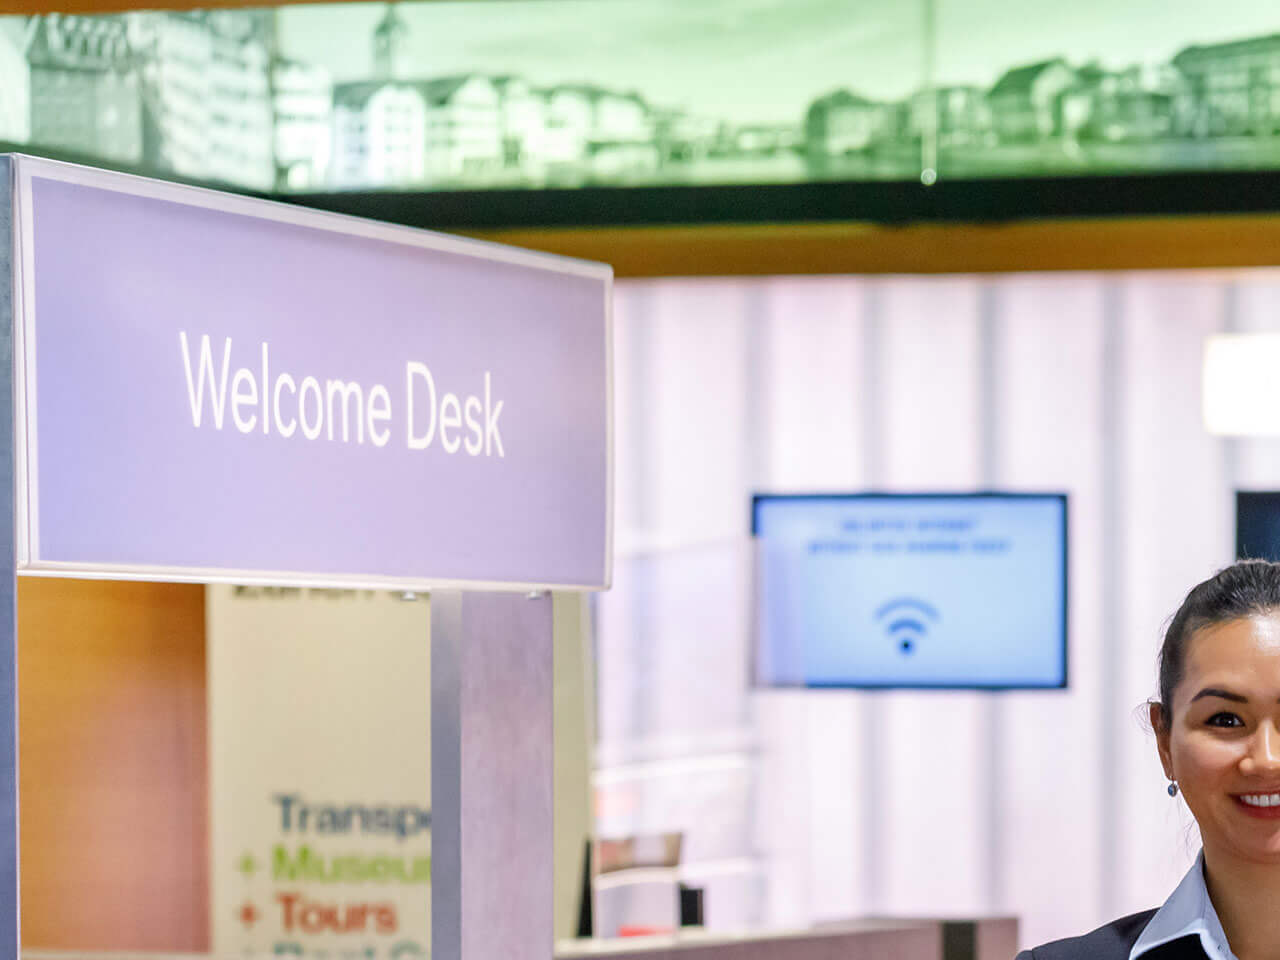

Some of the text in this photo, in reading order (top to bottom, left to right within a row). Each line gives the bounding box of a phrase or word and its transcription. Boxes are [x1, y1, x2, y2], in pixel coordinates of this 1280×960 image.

[180, 331, 505, 458] Welcome Desk
[272, 845, 431, 882] Museu
[275, 892, 398, 934] Tours
